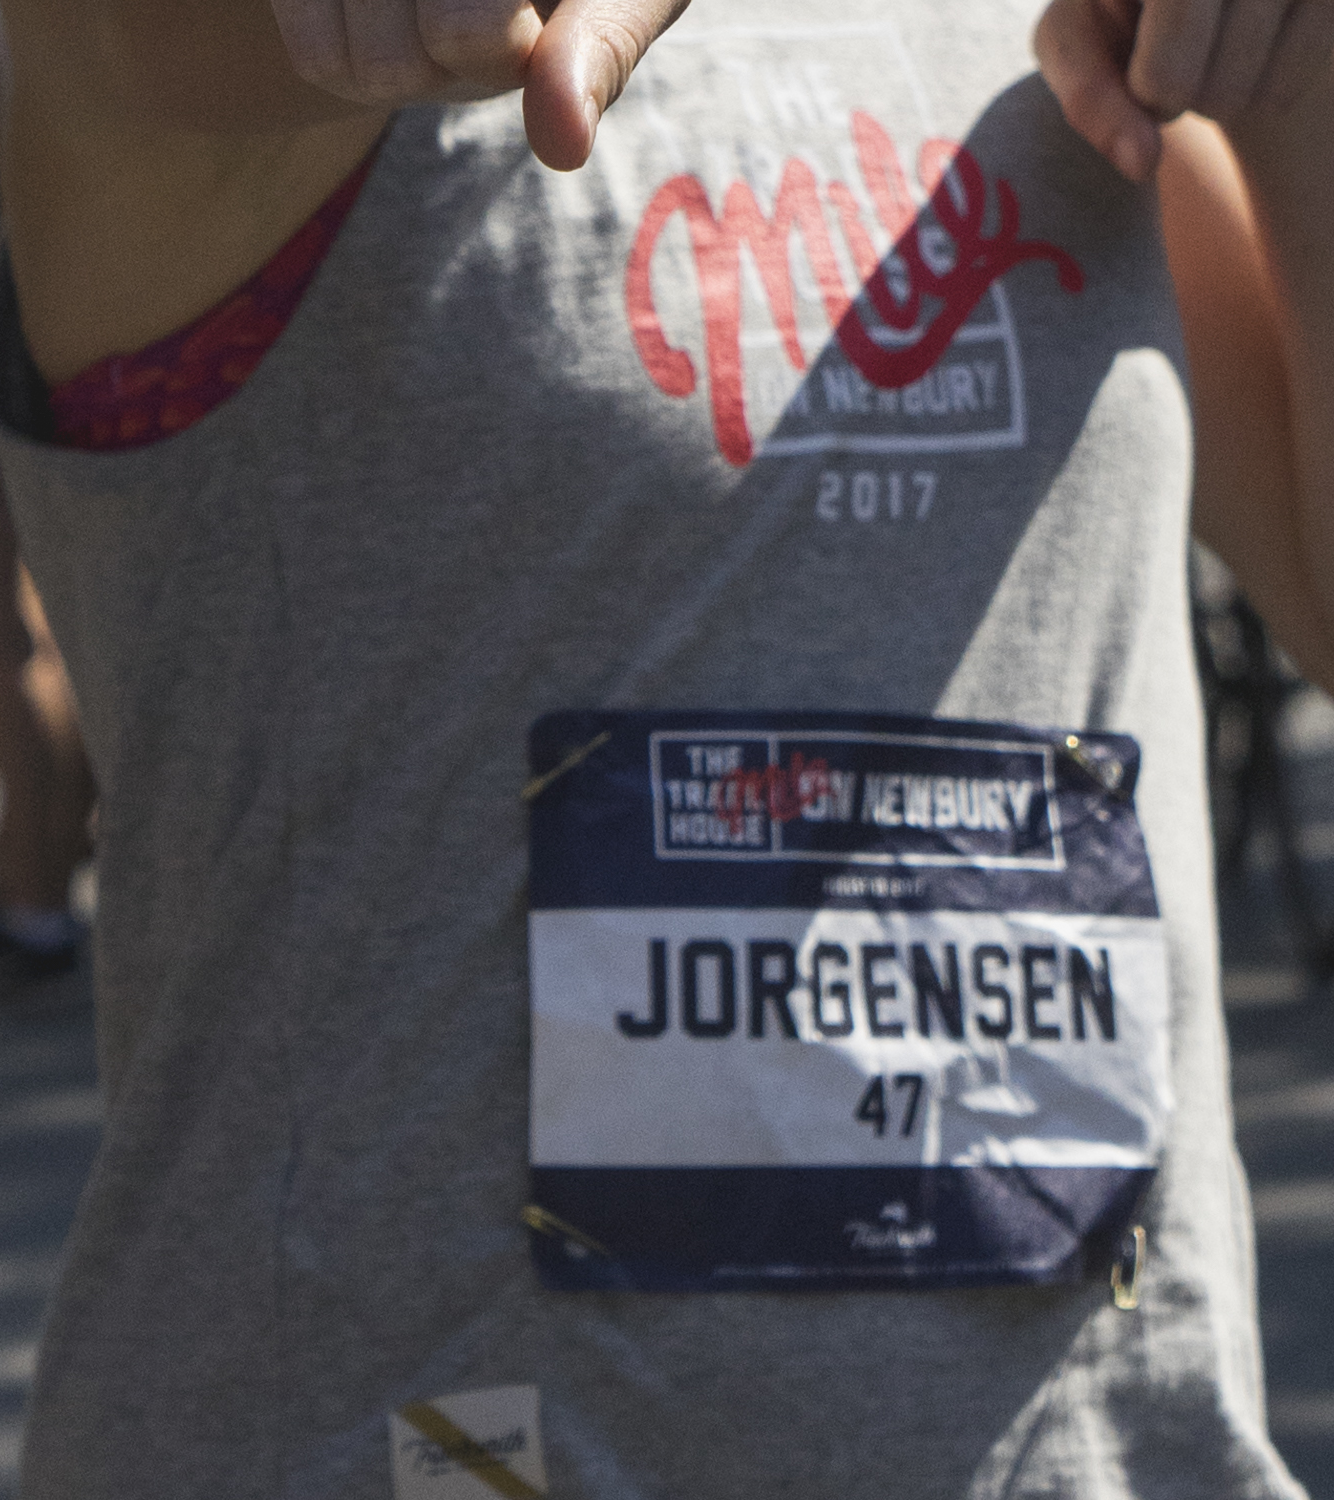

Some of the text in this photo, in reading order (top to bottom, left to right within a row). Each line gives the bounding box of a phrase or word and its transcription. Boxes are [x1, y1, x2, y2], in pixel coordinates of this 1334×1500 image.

[815, 470, 938, 522] 2017
[861, 773, 1034, 833] NEWBURY
[616, 939, 1118, 1042] JORGENSEN
[855, 1072, 925, 1139] 47
